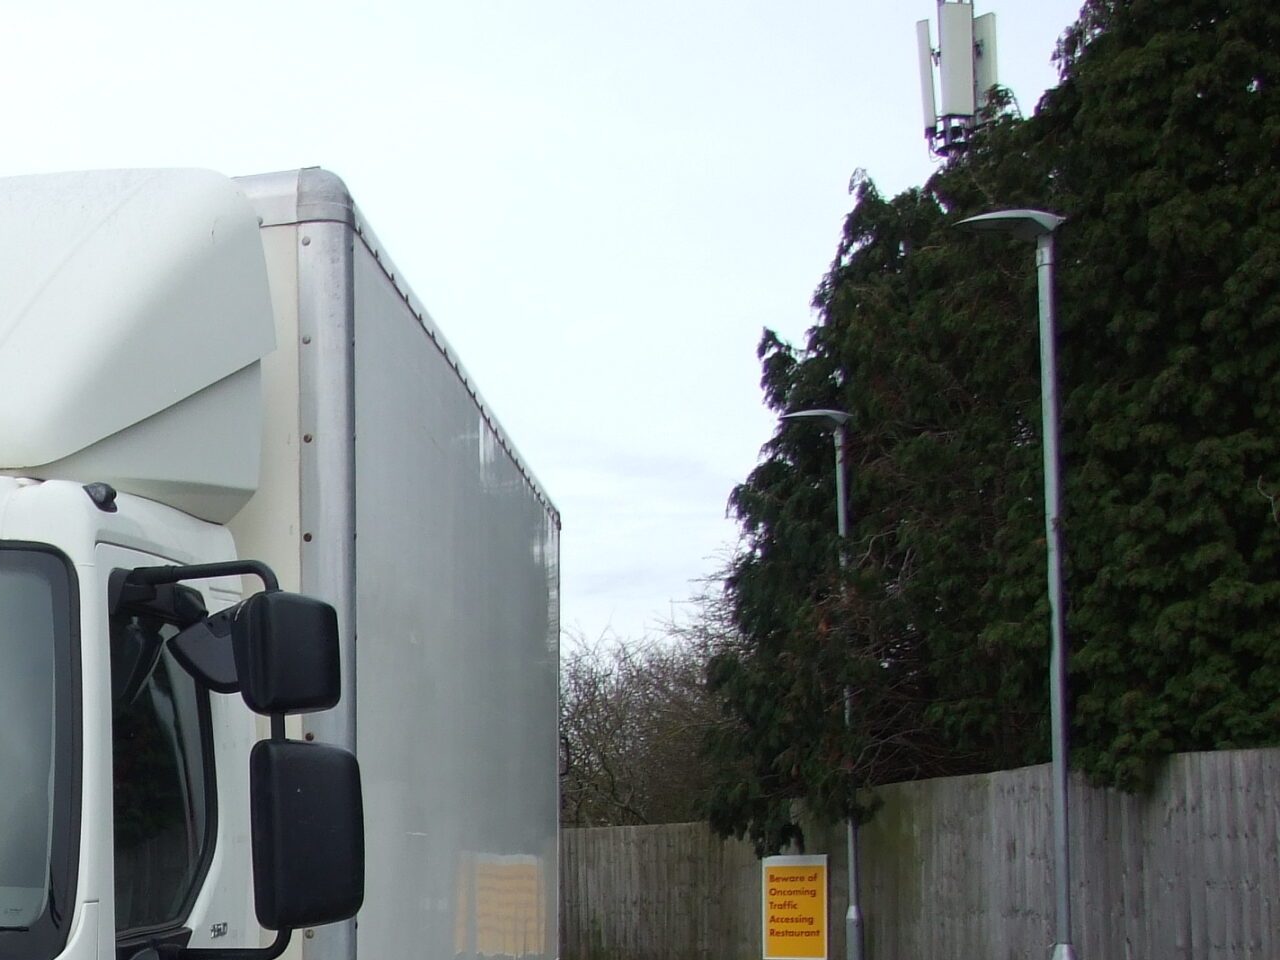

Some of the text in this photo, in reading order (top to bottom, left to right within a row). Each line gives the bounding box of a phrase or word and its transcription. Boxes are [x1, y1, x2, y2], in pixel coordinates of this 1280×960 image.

[769, 873, 818, 882] Beware of
[769, 887, 817, 897] Oncoming
[769, 901, 798, 910] Traffic
[769, 915, 814, 925] Accessing
[769, 929, 820, 937] Restaurant
